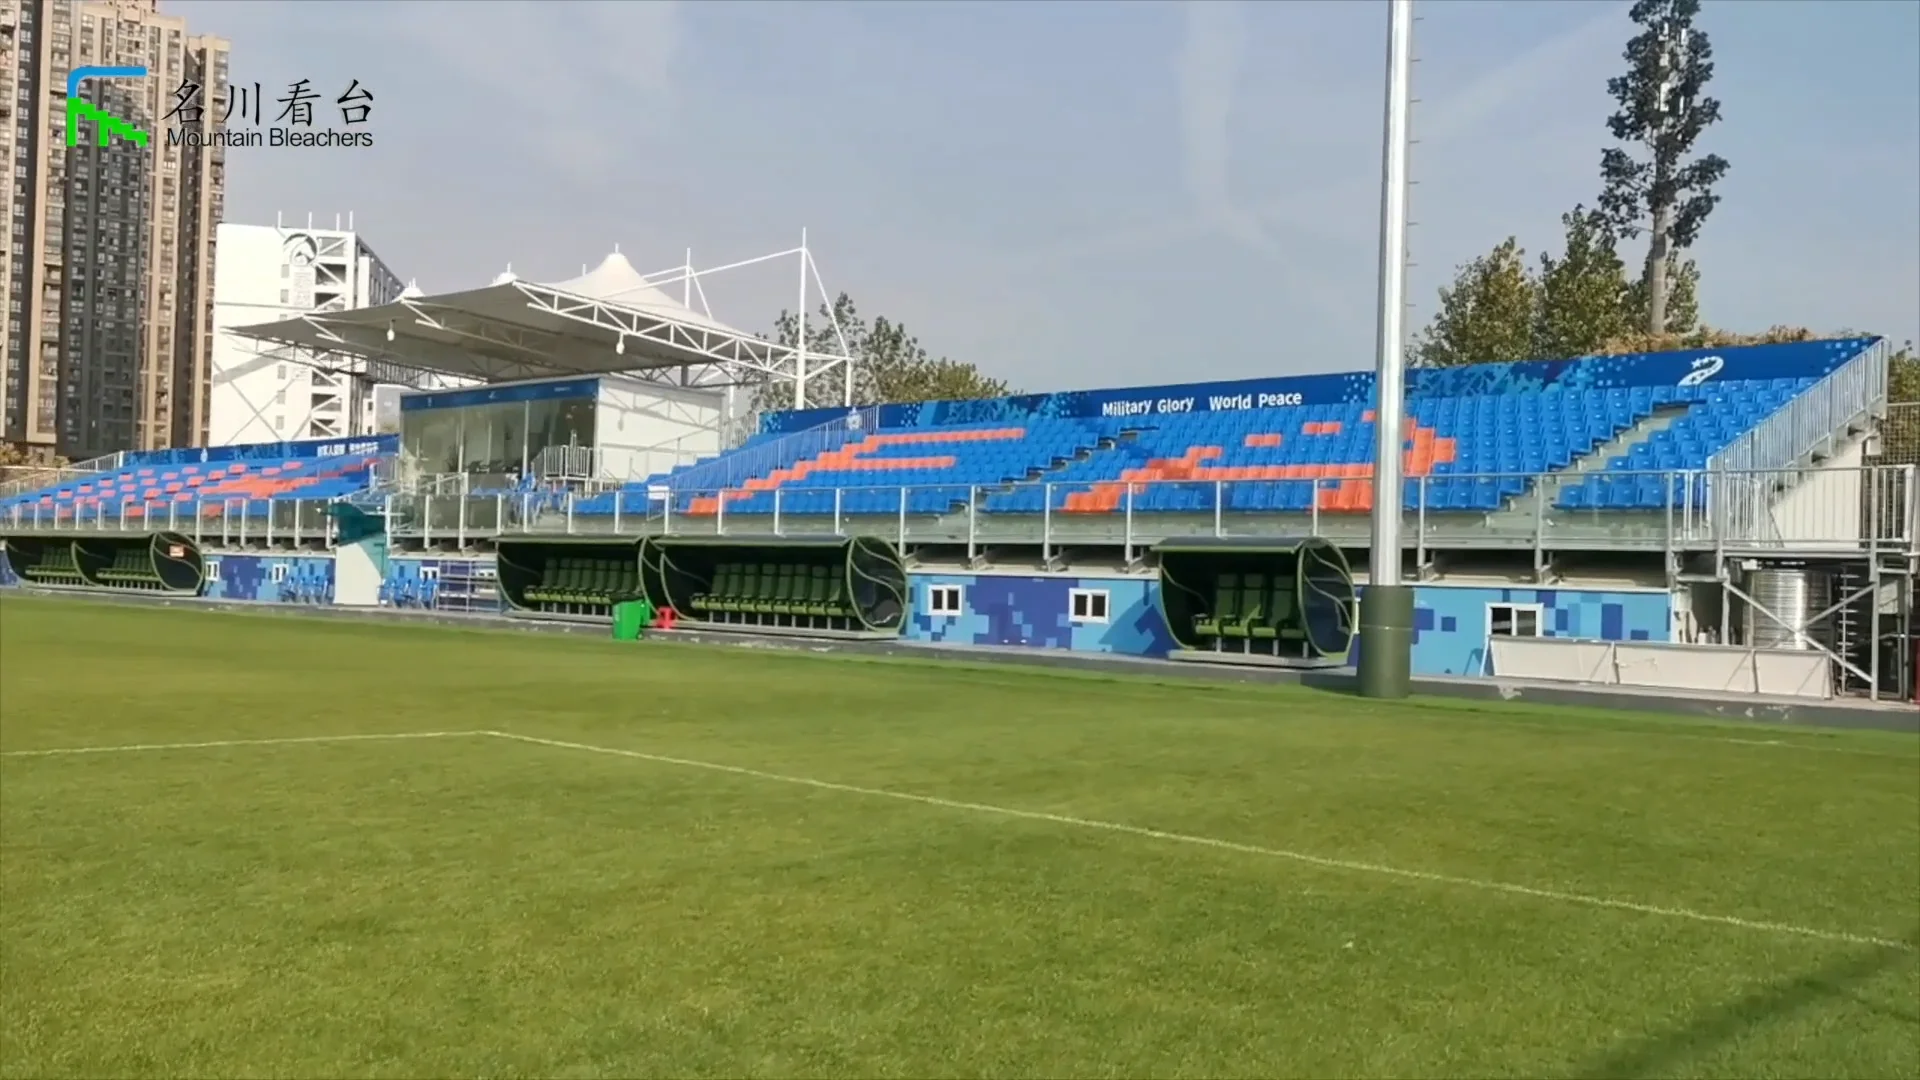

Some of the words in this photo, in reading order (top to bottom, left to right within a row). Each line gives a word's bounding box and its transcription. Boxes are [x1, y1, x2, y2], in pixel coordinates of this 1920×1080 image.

[1102, 399, 1152, 416] Military
[1157, 397, 1195, 413] Glory
[1209, 394, 1252, 410] World
[1258, 392, 1303, 407] Peace
